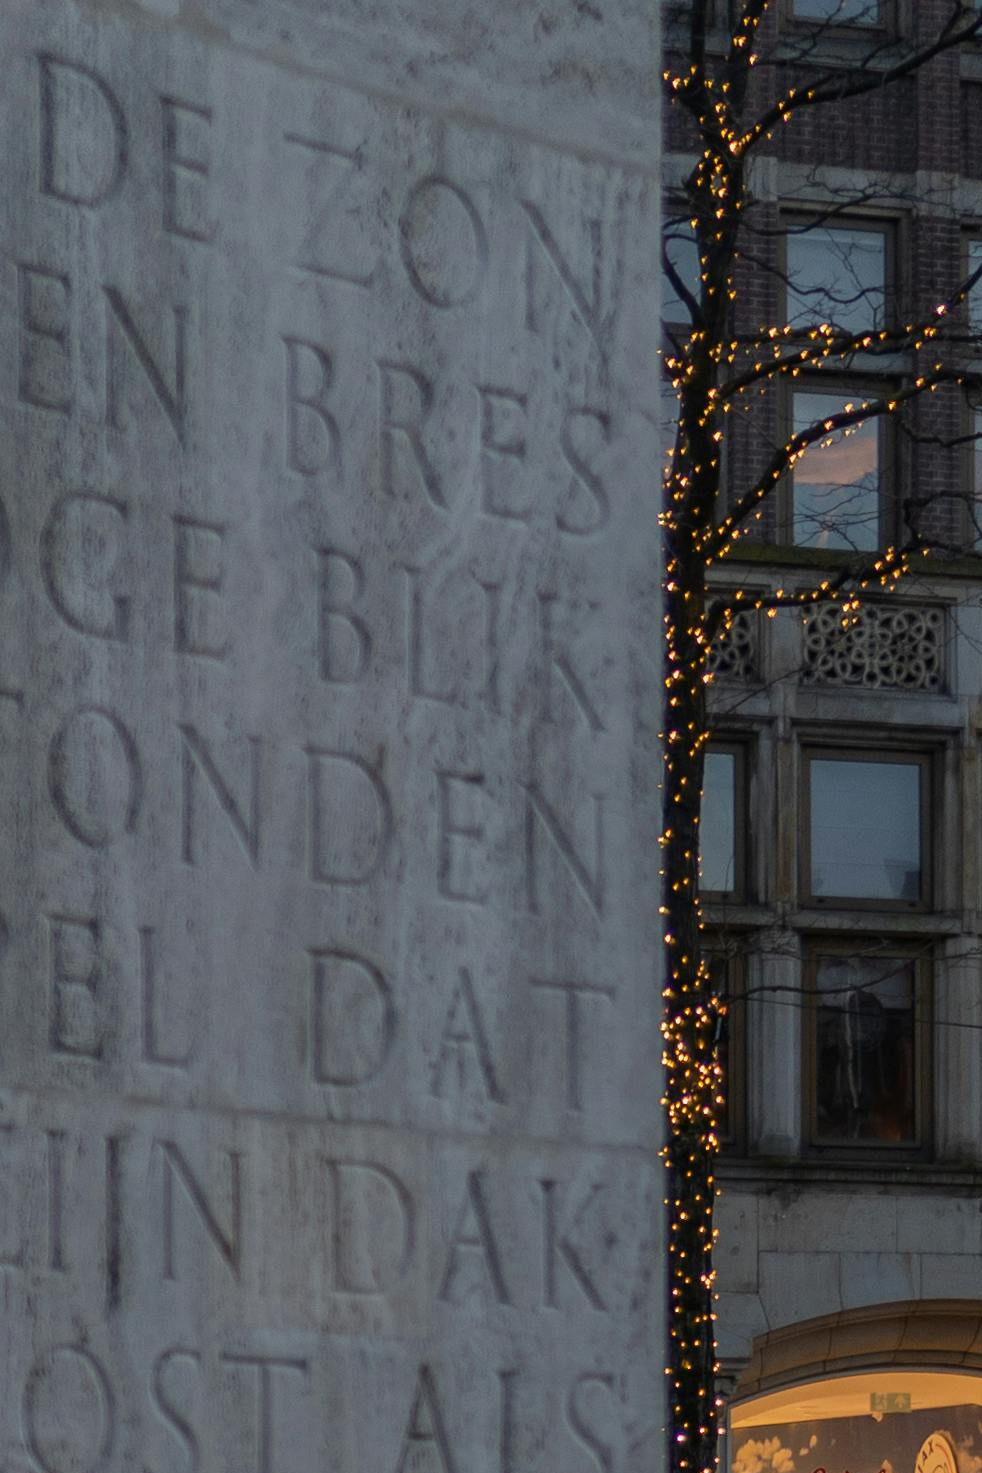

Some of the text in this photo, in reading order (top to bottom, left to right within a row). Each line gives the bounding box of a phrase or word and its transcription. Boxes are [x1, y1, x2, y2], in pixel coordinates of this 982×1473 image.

[36, 50, 612, 350] DE ZON
[280, 332, 612, 538] BRES
[0, 490, 225, 660] GE
[0, 690, 605, 915] ONDEN
[0, 910, 617, 1112] EL DAT
[322, 1155, 610, 1312] DAK
